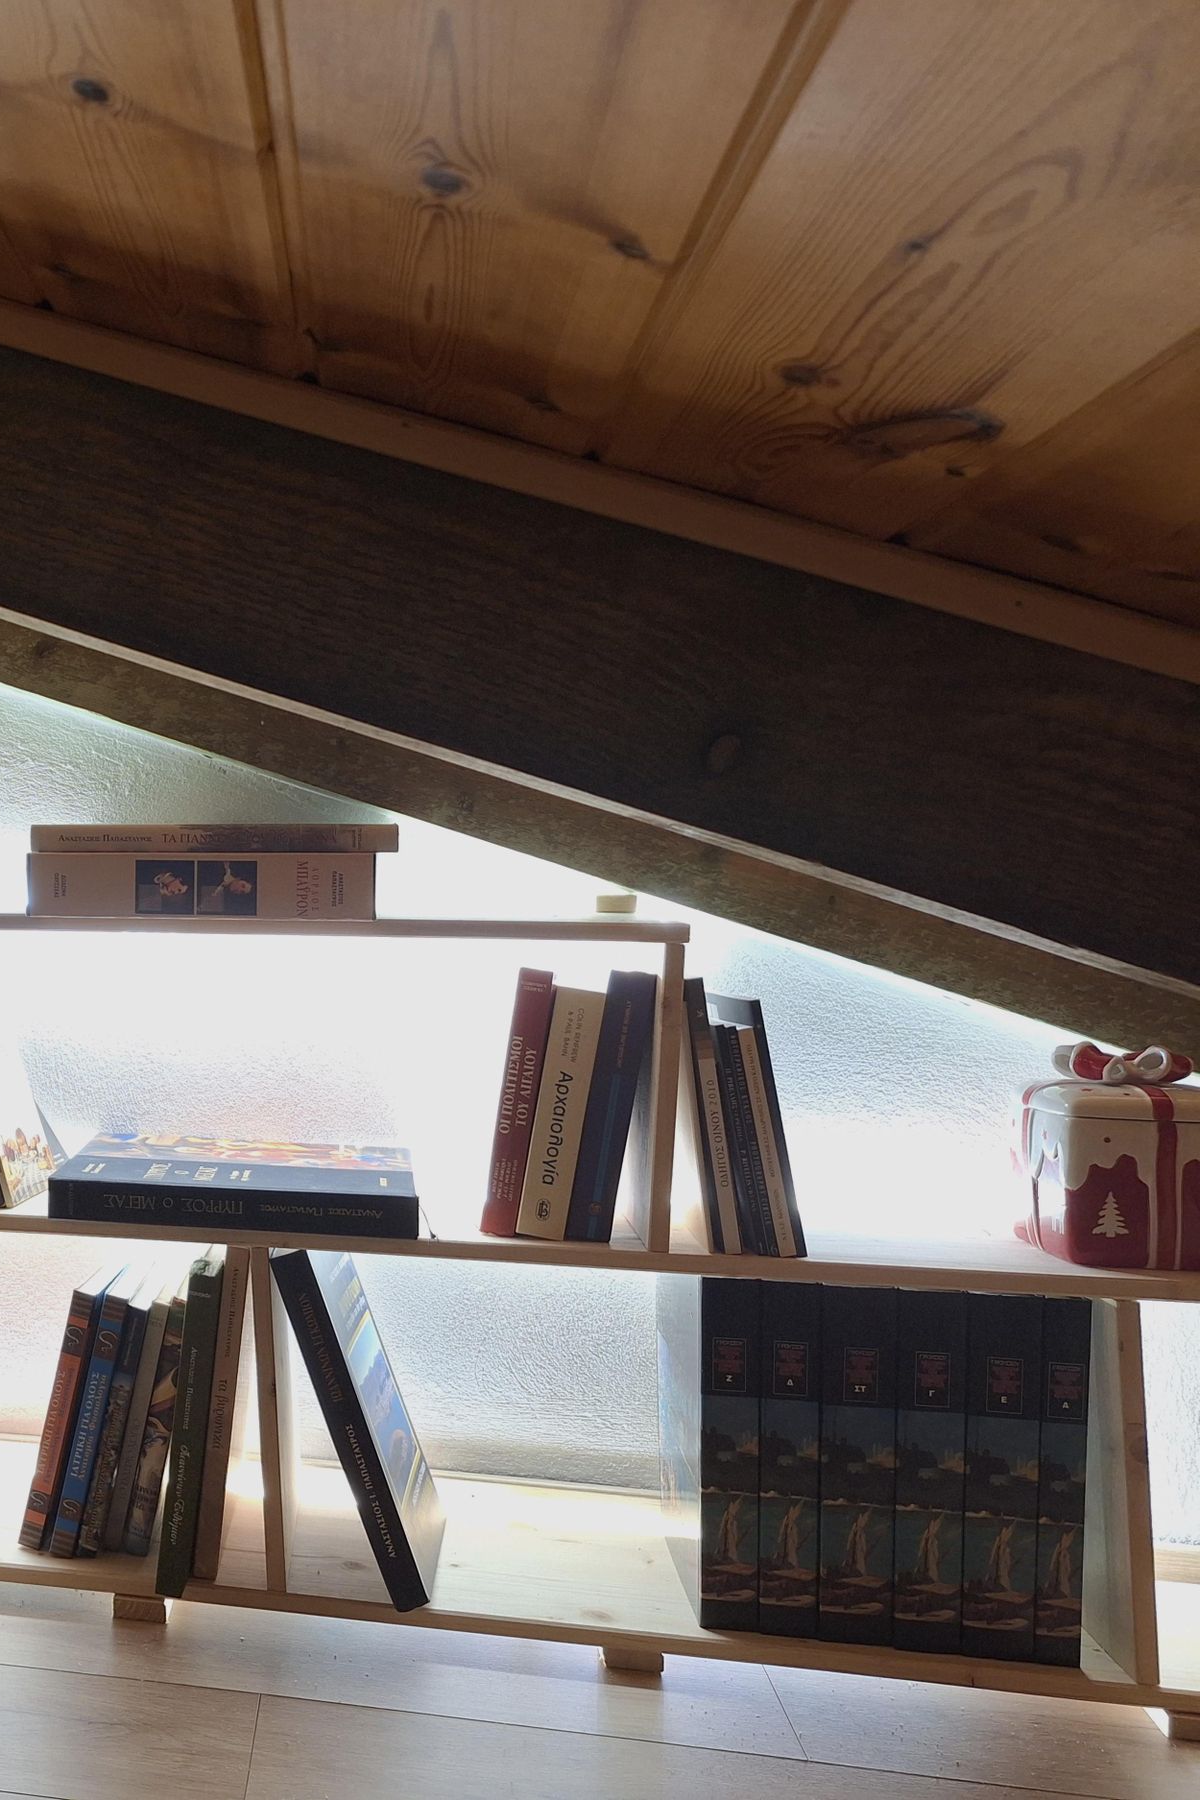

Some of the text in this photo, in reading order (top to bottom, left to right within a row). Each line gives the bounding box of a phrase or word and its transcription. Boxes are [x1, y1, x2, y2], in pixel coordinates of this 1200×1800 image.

[496, 1033, 523, 1135] ΟΙ ΠΟΛΙΤΙΣΜΟΙ
[516, 1045, 537, 1128] ΤΟΥ ΑΙΓΑΙΟΥ
[538, 1069, 576, 1187] Αρχαιολογία
[705, 1078, 730, 1188] ΟΔΗΓΟΣ ΟΙΝΟΥ 2010
[83, 1370, 100, 1410] ΟΛΟΥΣ
[217, 1378, 228, 1392] τα
[1000, 1396, 1008, 1404] Ε
[79, 1410, 92, 1429] ΓΙΑ
[68, 1430, 87, 1477] ΙΑΤΡΙΚΗ
[342, 1421, 374, 1490] ΠΑΠΑΣΤΑΥΡΟΣ
[368, 1499, 398, 1559] ΑΝΑΣΤΑΣΙΟΣ
